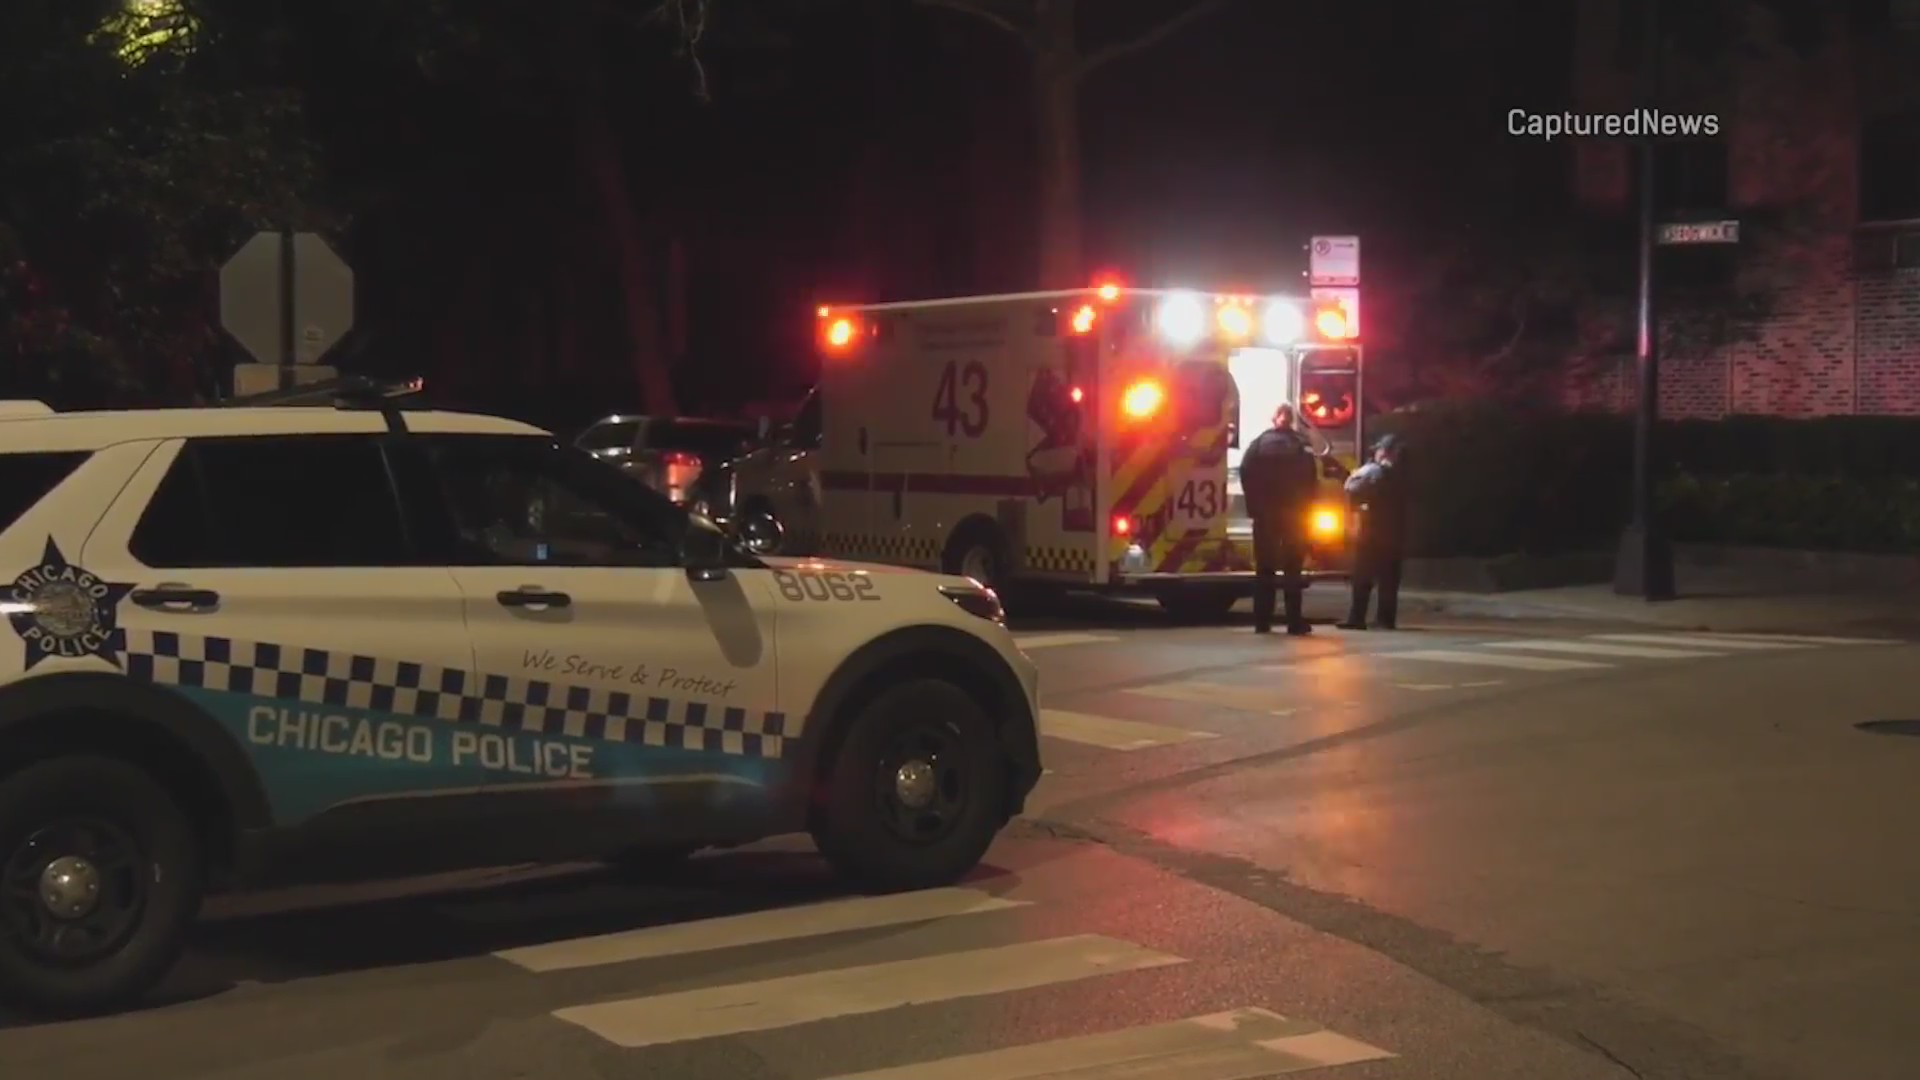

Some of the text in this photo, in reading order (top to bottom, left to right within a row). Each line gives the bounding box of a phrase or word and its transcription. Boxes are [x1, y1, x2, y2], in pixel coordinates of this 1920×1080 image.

[931, 359, 989, 439] 43
[1177, 480, 1217, 519] 43
[11, 564, 109, 601] CHICAGO
[773, 569, 881, 601] 8062
[22, 623, 112, 656] POLICE
[523, 649, 738, 697] We Serve & Protect
[248, 705, 594, 779] CHICAGO POLICE
